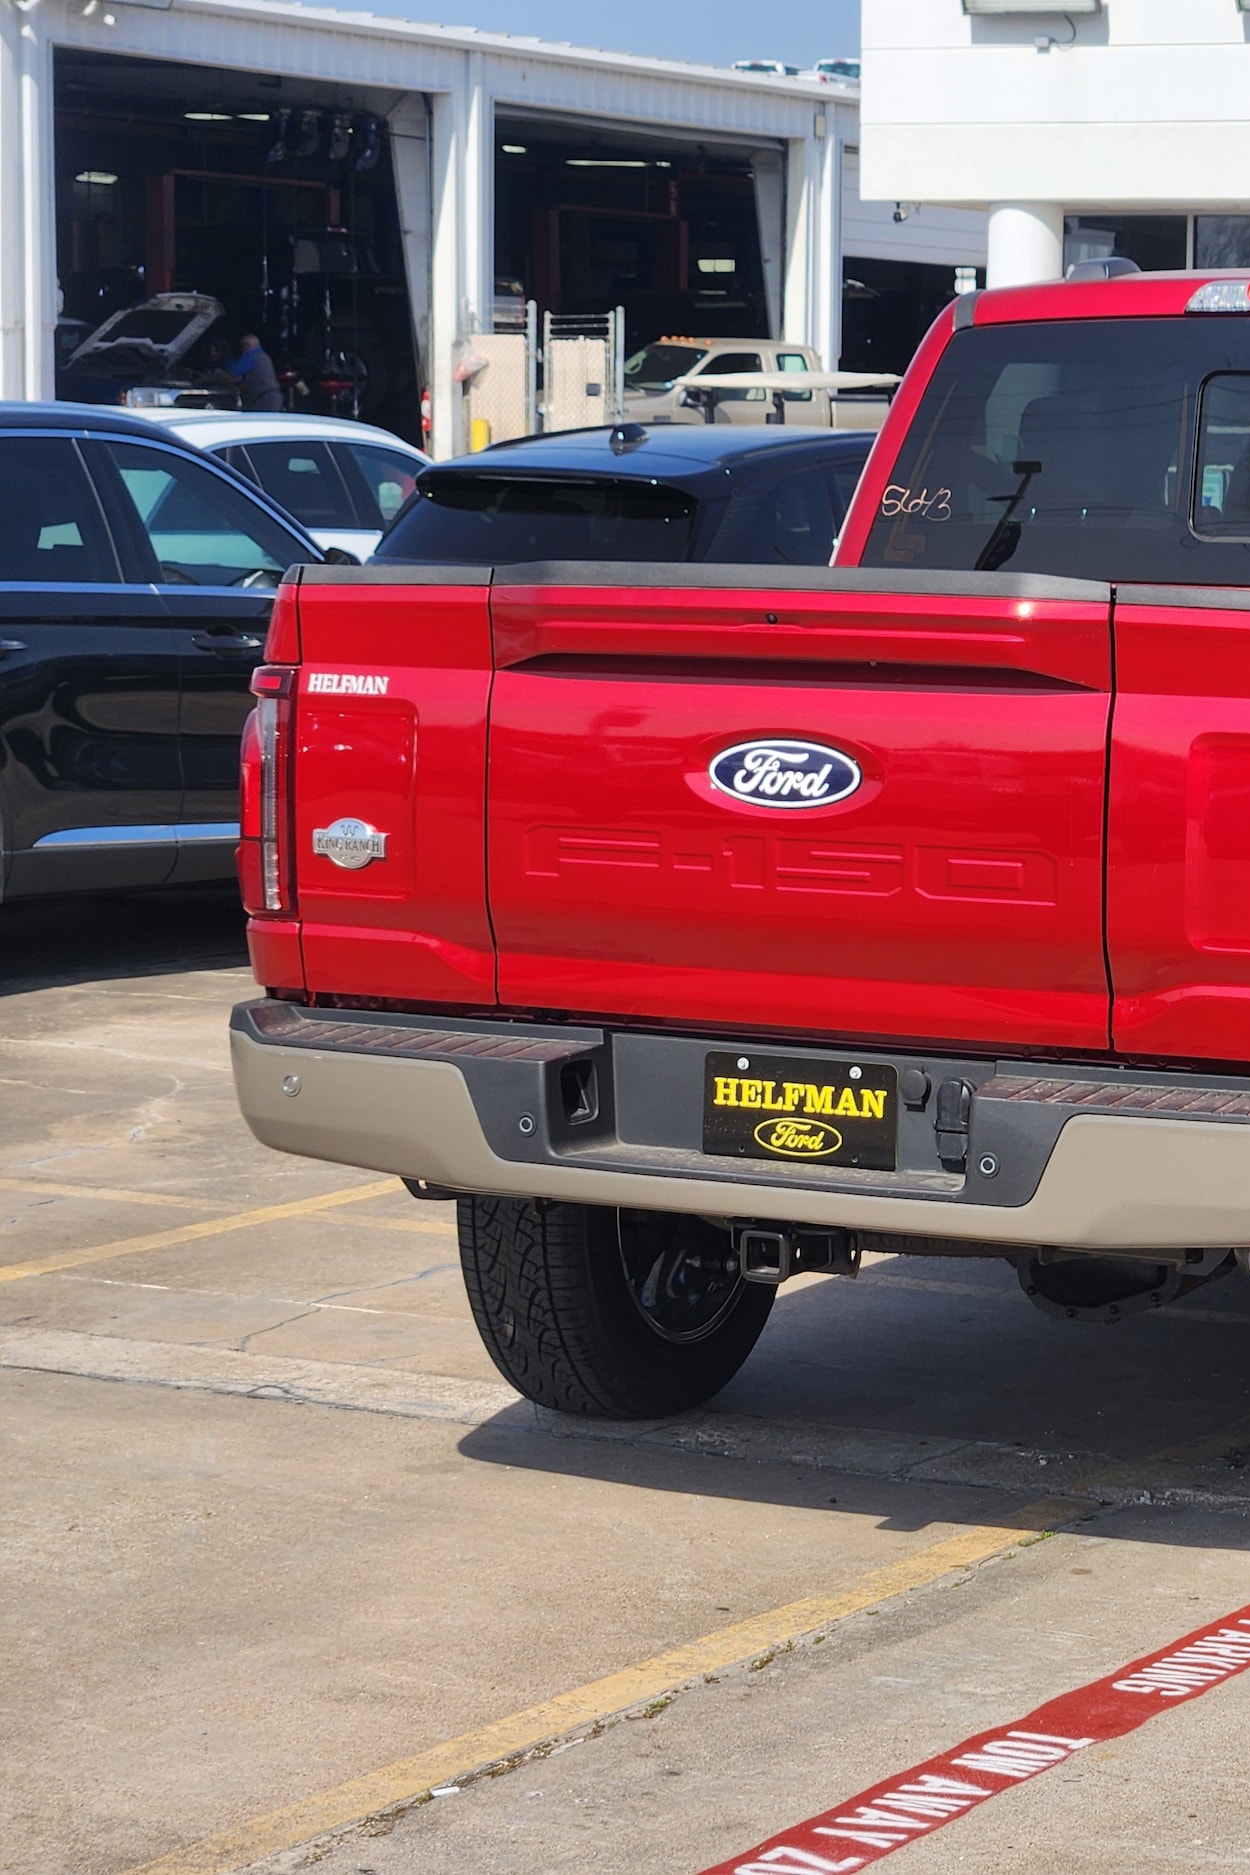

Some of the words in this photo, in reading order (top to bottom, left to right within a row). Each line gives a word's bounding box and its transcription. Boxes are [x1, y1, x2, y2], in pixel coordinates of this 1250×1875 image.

[882, 485, 952, 521] 5643
[308, 673, 389, 694] HELFMAN
[733, 748, 834, 798] Ford
[317, 836, 343, 851] KING
[345, 839, 380, 852] RANCH
[524, 824, 1058, 907] F-150
[713, 1077, 888, 1119] HELFMAN
[770, 1120, 825, 1151] Ford
[951, 1730, 1097, 1778] TOW
[812, 1774, 993, 1849] AWAY
